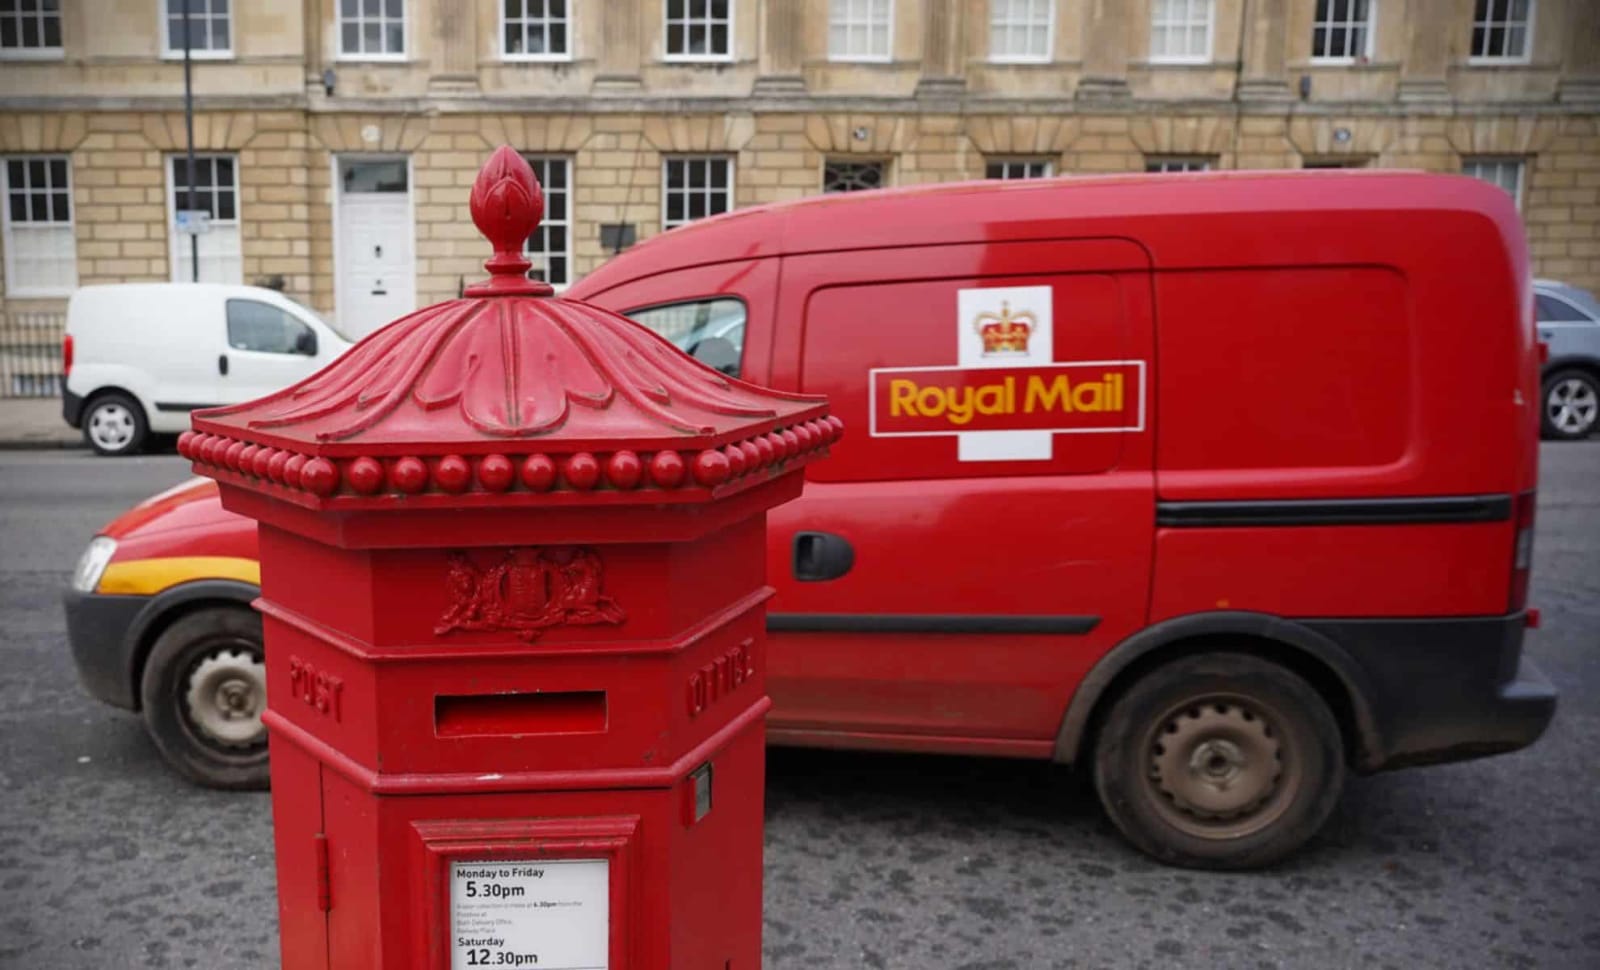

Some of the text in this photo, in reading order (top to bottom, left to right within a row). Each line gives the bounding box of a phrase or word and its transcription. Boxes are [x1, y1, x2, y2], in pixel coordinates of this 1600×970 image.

[890, 372, 1124, 425] Royal Mail
[686, 638, 753, 718] OFFICE
[289, 654, 344, 724] POST
[457, 867, 545, 880] Monday to Friday
[466, 881, 525, 899] 5.30pm
[458, 936, 505, 948] Saturday
[466, 948, 538, 967] 12.30pm
